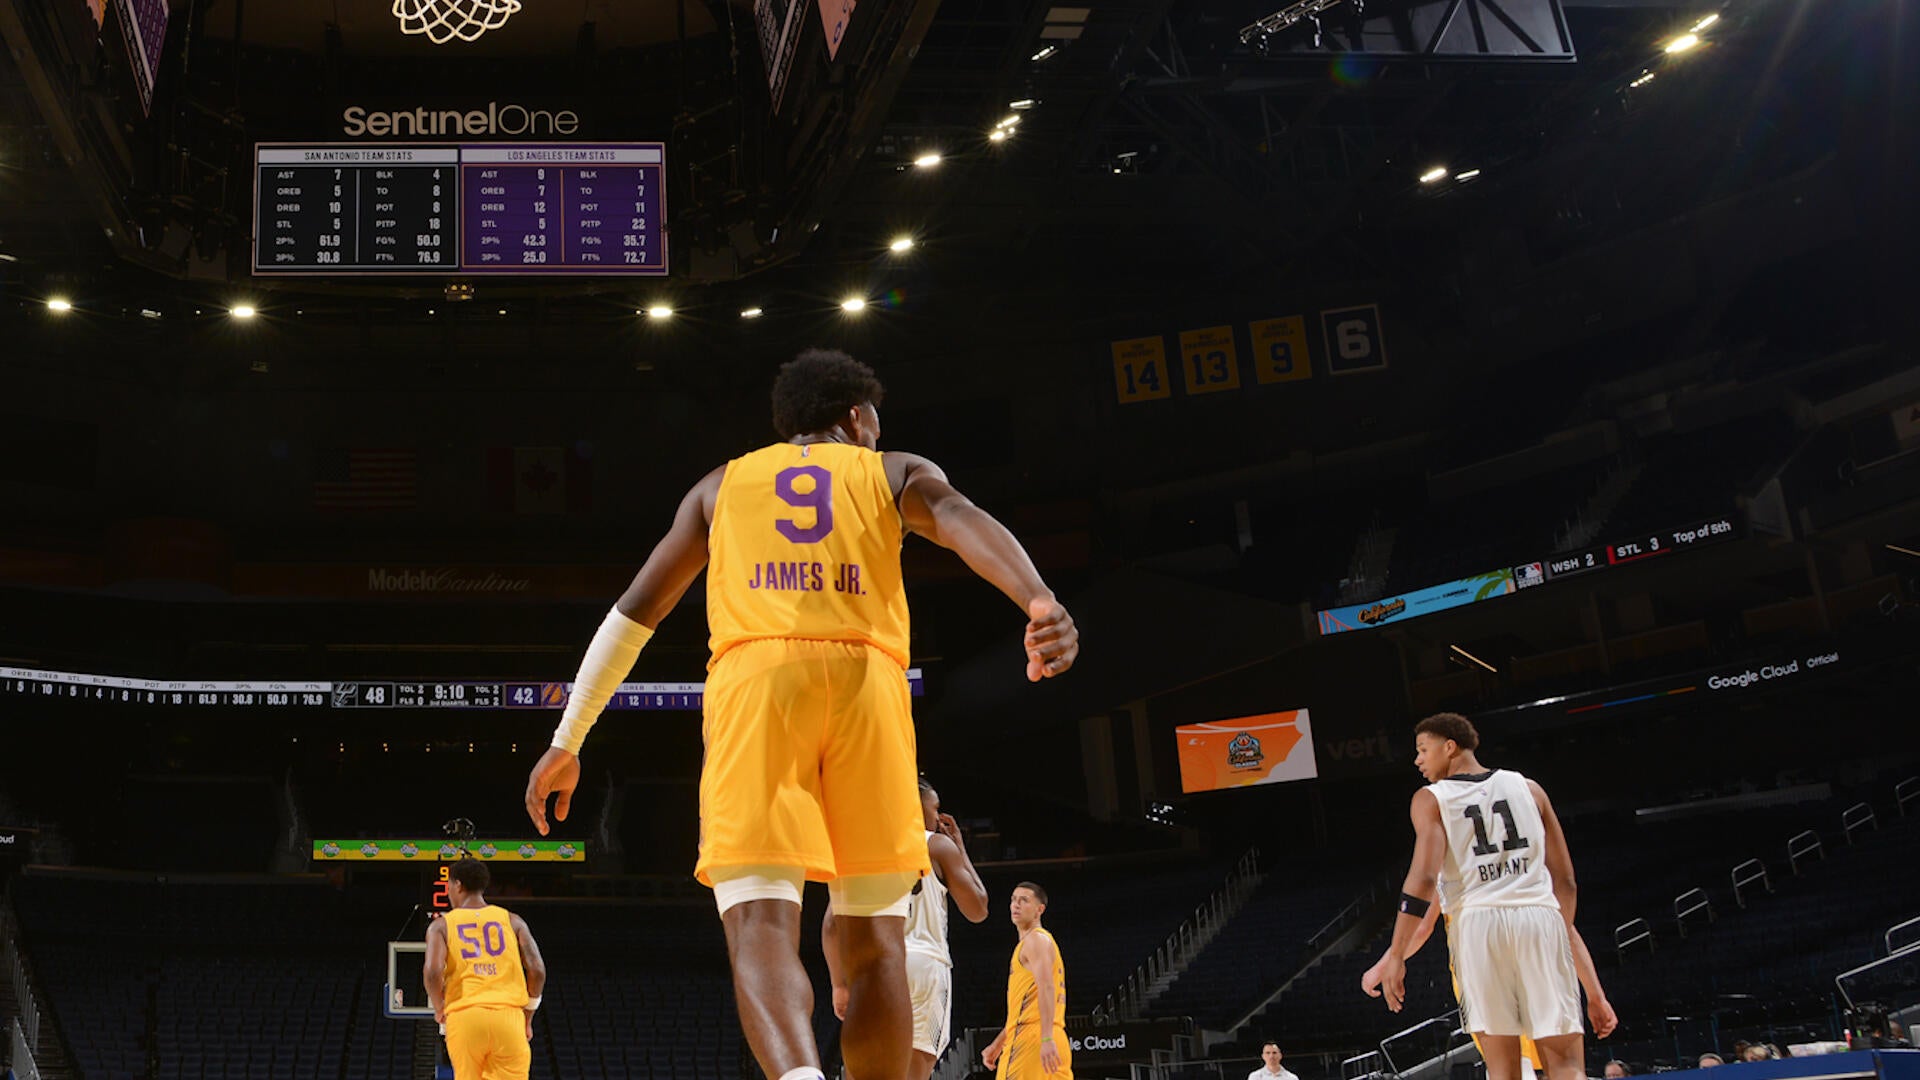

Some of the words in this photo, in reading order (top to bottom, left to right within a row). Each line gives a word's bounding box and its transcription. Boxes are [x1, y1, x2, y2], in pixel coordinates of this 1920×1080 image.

[343, 101, 579, 136] SentinelOne
[304, 152, 322, 161] SAN
[323, 152, 360, 161] ANTONIO
[362, 152, 384, 161] TEAM
[386, 152, 413, 161] STATS
[507, 151, 525, 160] LOS
[526, 151, 563, 160] ANGELES
[565, 151, 587, 160] TEAM
[589, 151, 616, 160] STATS
[277, 171, 294, 179] AST
[334, 169, 342, 181] 7
[375, 171, 393, 179] BLK
[433, 169, 440, 180] 4
[480, 170, 498, 178] AST
[537, 168, 545, 180] 9
[580, 170, 597, 178] BLK
[638, 169, 645, 180] 1
[277, 187, 302, 195] OREB
[334, 185, 341, 197] 5
[376, 187, 388, 195] TO
[433, 185, 440, 197] 8
[480, 187, 505, 195] OREB
[537, 185, 545, 197] 7
[580, 187, 592, 195] TO
[637, 185, 645, 197] 7
[276, 203, 301, 212] DREB
[329, 202, 341, 213] 10
[375, 203, 394, 211] POT
[433, 202, 440, 213] 8
[481, 203, 505, 211] DREB
[534, 202, 546, 213] 12
[580, 203, 599, 211] POT
[635, 202, 645, 213] 11
[276, 220, 292, 228] STL
[333, 218, 341, 230] 5
[375, 220, 396, 228] PITP
[429, 218, 440, 230] 18
[481, 220, 497, 228] STL
[538, 218, 546, 230] 5
[580, 220, 601, 228] PITP
[631, 218, 646, 230] 22
[319, 235, 341, 246] 61.9
[416, 235, 440, 246] 50.0
[522, 235, 546, 246] 42.3
[623, 235, 646, 246] 35.7
[316, 251, 341, 263] 30.8
[417, 251, 440, 263] 76.9
[522, 251, 547, 263] 25.0
[623, 251, 647, 263] 72.7
[1335, 319, 1371, 360] 6
[1269, 342, 1293, 374] 9
[1191, 350, 1229, 386] 13
[1123, 360, 1160, 395] 14
[775, 465, 833, 543] 9
[1672, 532, 1696, 544] Top
[1697, 525, 1710, 538] of
[1711, 520, 1731, 534] 5th
[1649, 537, 1659, 551] 3
[1616, 544, 1642, 557] STL
[1551, 557, 1580, 573] WSH
[1585, 553, 1595, 567] 2
[368, 568, 436, 592] Modelo
[749, 561, 824, 592] JAMES
[834, 563, 867, 595] JR.
[1806, 652, 1839, 668] Official
[1707, 670, 1759, 690] Google
[1759, 659, 1799, 680] Cloud
[17, 680, 25, 692] 5
[42, 683, 53, 695] 10
[95, 688, 103, 699] 4
[121, 690, 129, 702] 8
[147, 692, 155, 704] 8
[172, 693, 183, 705] 18
[232, 693, 254, 705] 30.8
[267, 693, 288, 705] 50.0
[303, 694, 323, 705] 76.9
[364, 687, 385, 704] 48
[399, 685, 415, 693] TOL
[417, 684, 424, 695] 2
[434, 684, 464, 700] 9:10
[474, 685, 490, 694] TOL
[493, 685, 500, 695] 2
[513, 687, 534, 704] 42
[399, 697, 415, 705] FLS
[417, 696, 424, 706] 0
[474, 697, 490, 705] FLS
[493, 697, 500, 706] 2
[628, 695, 640, 706] 12
[655, 695, 664, 706] 5
[682, 695, 689, 706] 1
[1463, 799, 1530, 856] 11
[439, 866, 450, 881] 9
[432, 881, 449, 907] 2
[456, 921, 506, 960] 50
[1083, 1034, 1126, 1051] Cloud
